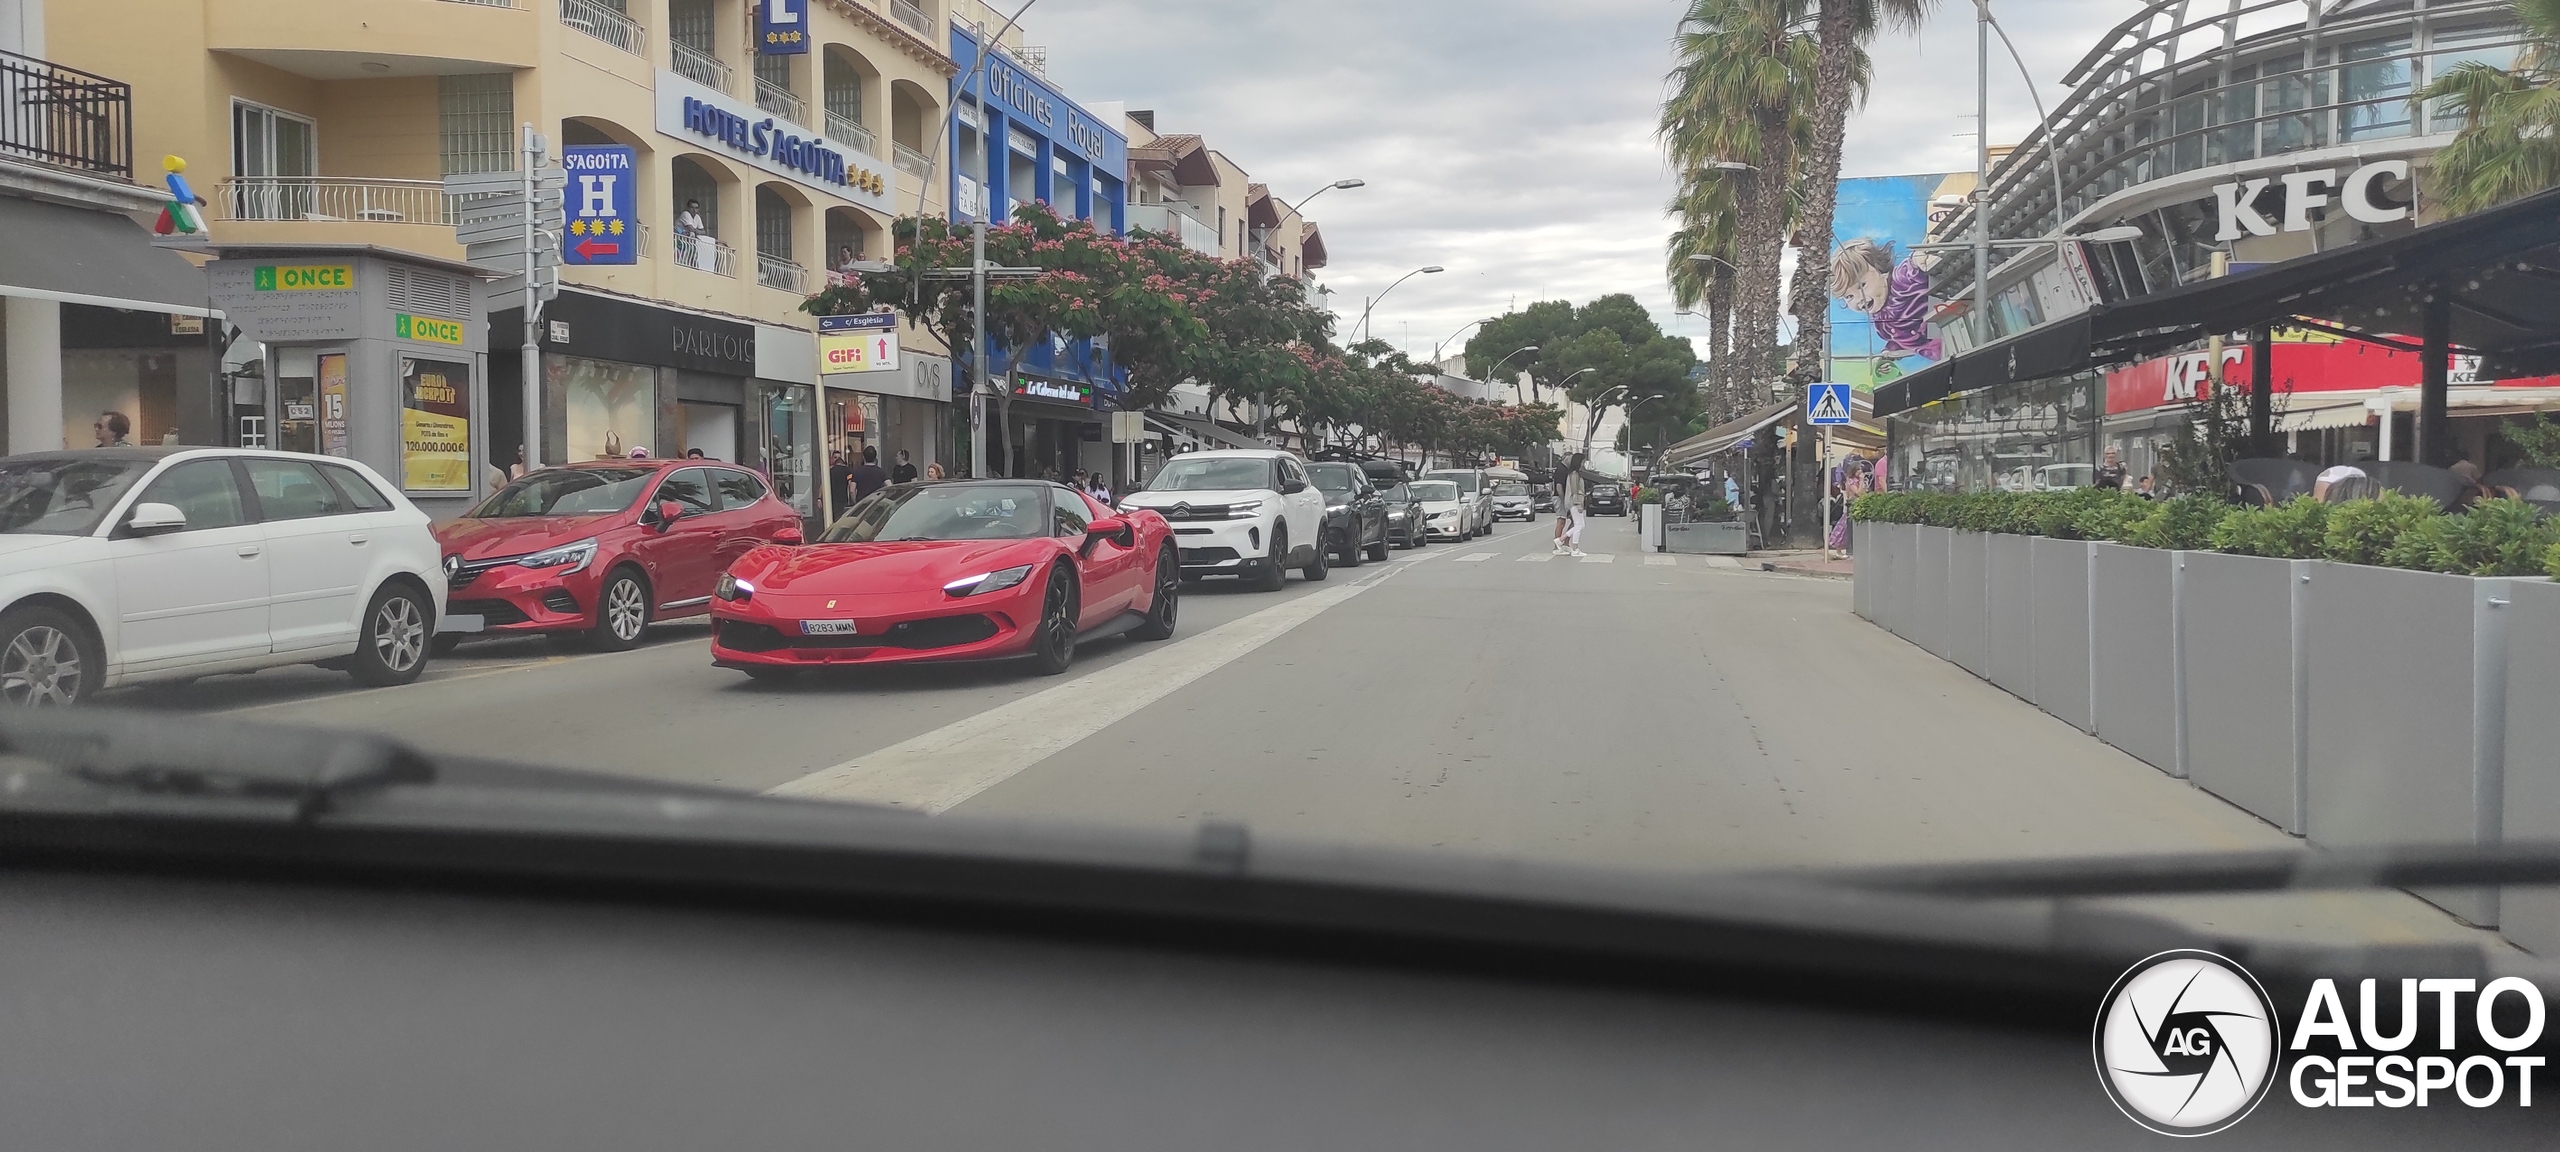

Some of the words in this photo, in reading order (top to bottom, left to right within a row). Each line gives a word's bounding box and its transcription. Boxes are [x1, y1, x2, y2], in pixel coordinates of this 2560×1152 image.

[989, 59, 1053, 128] Oficines
[1066, 106, 1106, 162] Royal
[579, 175, 617, 217] H
[2212, 159, 2408, 242] KFC
[284, 269, 346, 286] ONCE
[417, 320, 458, 341] ONCE
[917, 361, 940, 388] OVS
[2163, 348, 2244, 401] KFC
[2451, 372, 2478, 383] KF
[324, 394, 343, 420] 15
[406, 441, 457, 453] 120.000.000
[458, 443, 465, 452] €
